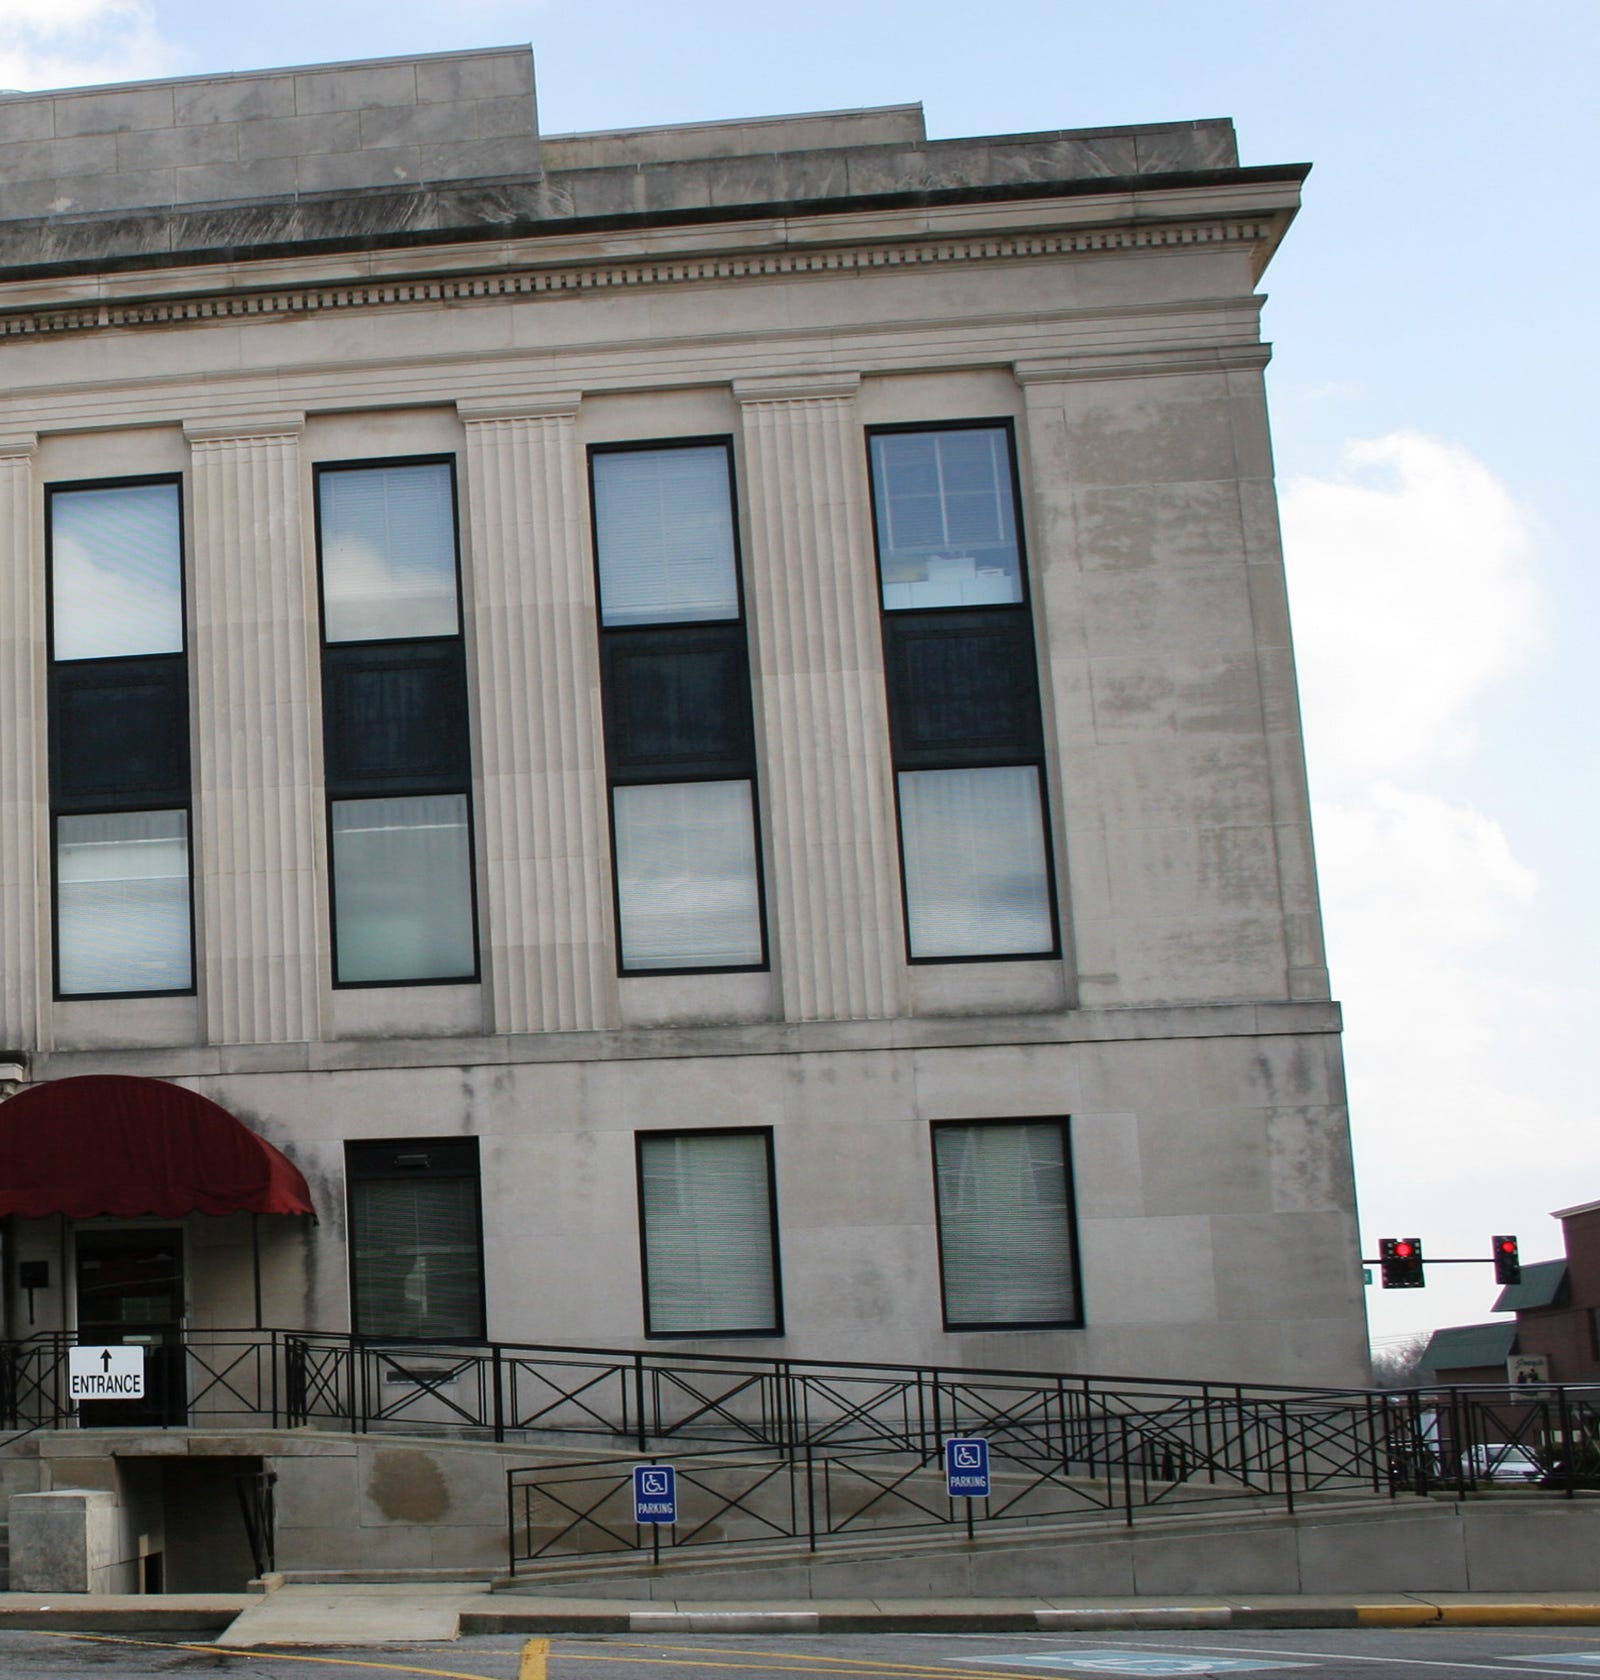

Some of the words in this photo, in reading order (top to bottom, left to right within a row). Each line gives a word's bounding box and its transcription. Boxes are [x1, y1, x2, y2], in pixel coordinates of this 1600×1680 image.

[72, 1375, 141, 1394] ENTRANCE
[950, 1476, 987, 1488] PARKING
[638, 1502, 673, 1515] PARKING
